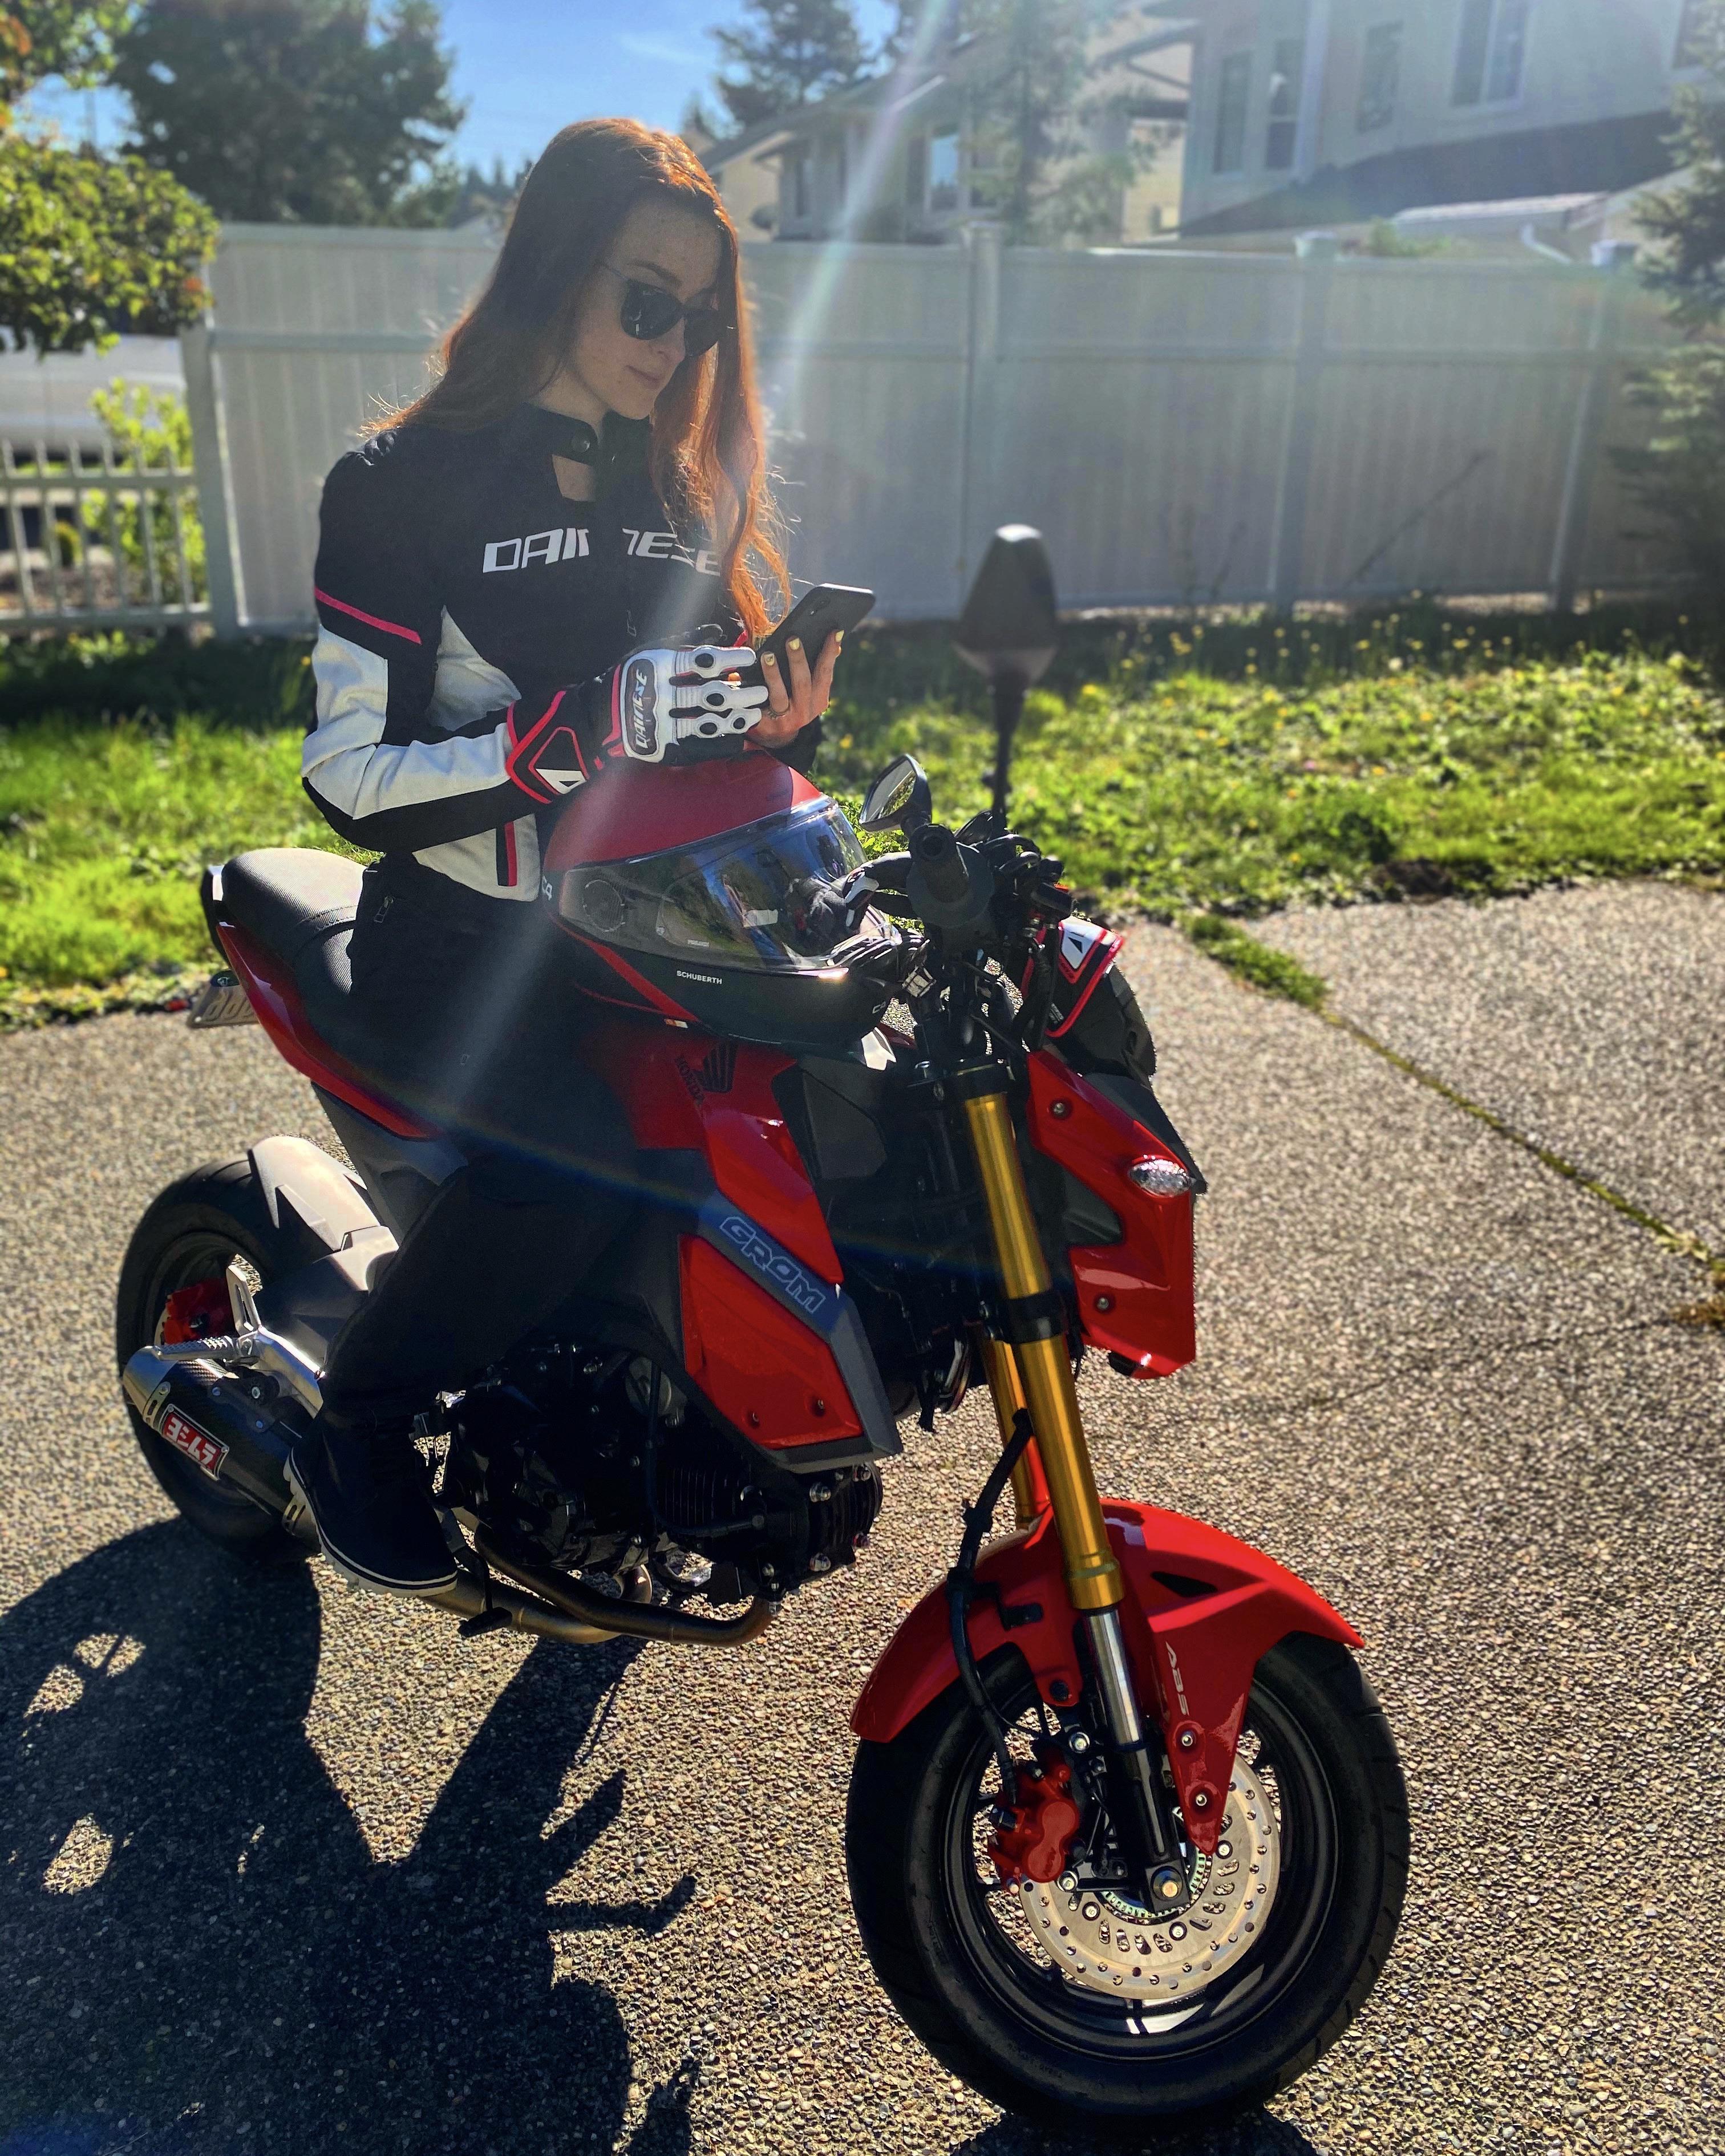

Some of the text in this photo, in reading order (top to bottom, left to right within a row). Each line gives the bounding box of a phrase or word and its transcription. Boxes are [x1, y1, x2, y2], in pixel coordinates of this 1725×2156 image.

[633, 668, 649, 748] DAINESE
[677, 970, 722, 984] SCHUBERTH
[719, 1216, 826, 1314] GROM
[166, 1416, 217, 1465] ヨシムラ
[1165, 1641, 1189, 1716] ABS
